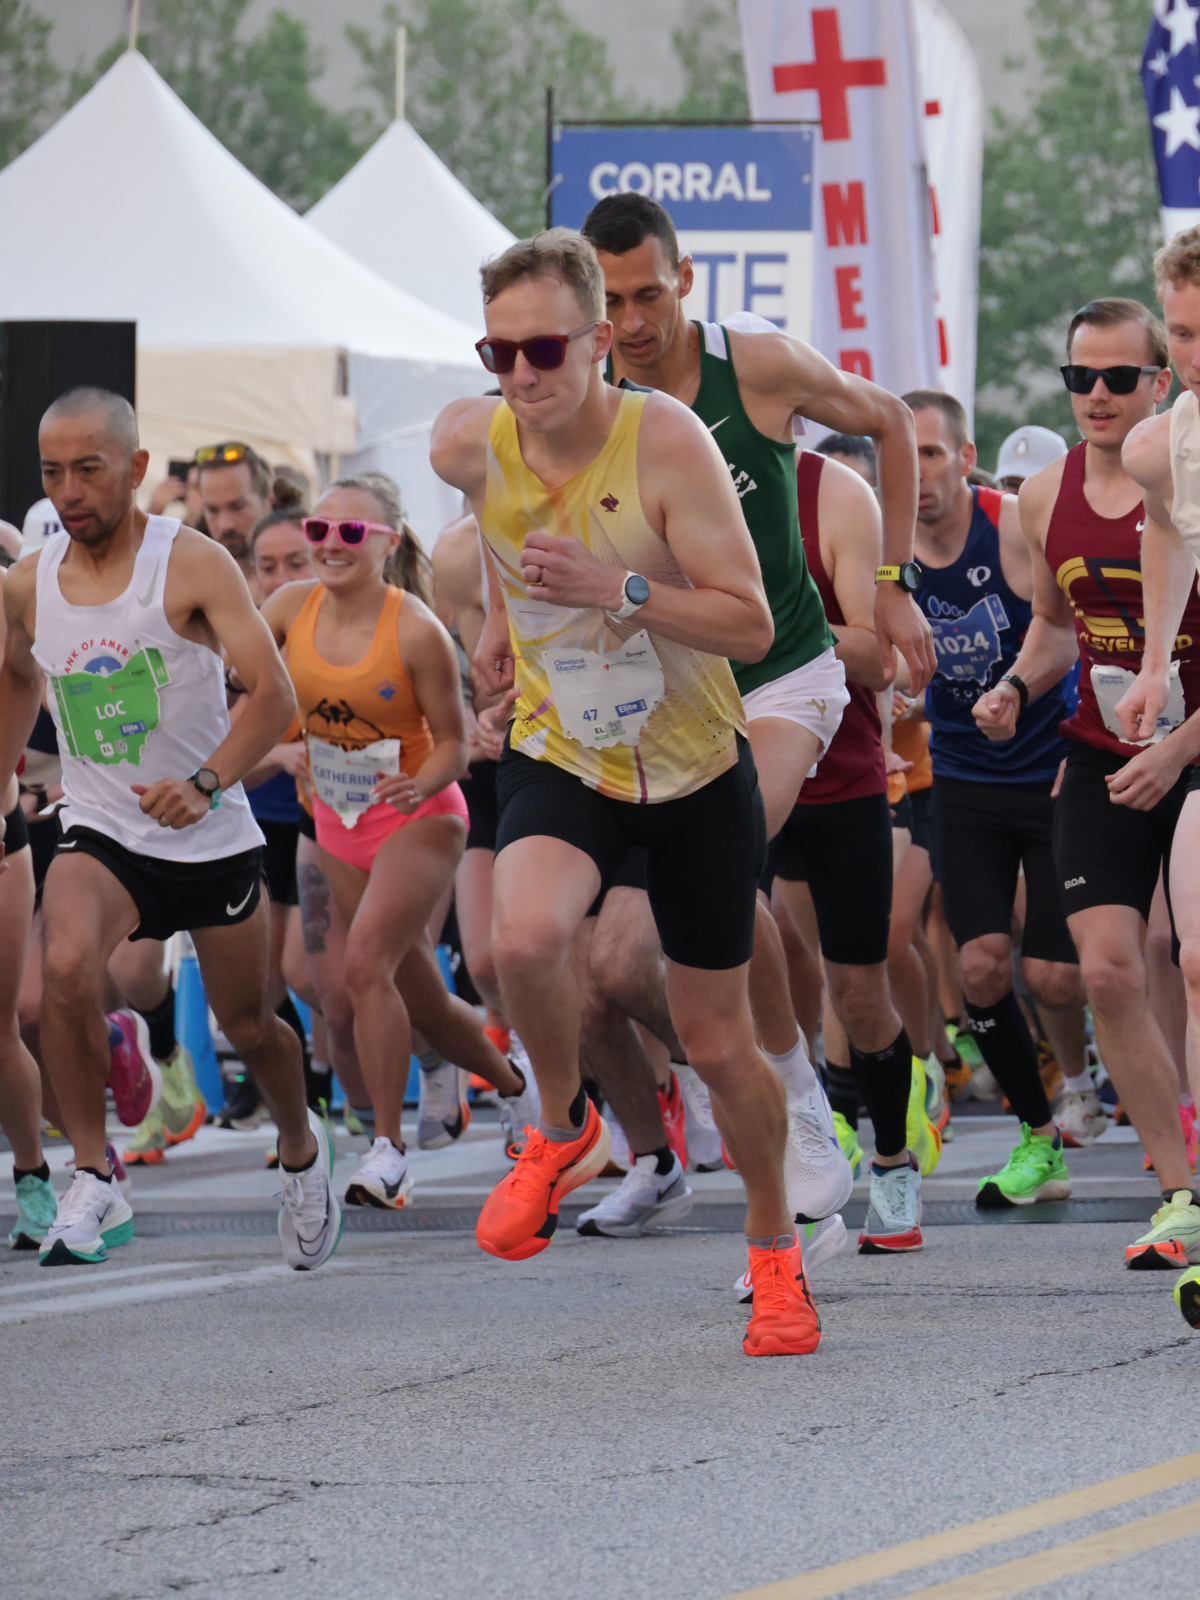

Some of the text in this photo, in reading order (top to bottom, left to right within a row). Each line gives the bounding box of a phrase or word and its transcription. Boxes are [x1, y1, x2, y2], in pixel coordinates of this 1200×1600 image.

[589, 161, 772, 201] CORRAL
[933, 631, 990, 655] 1024
[1079, 631, 1193, 653] CLEVELD
[64, 638, 133, 674] ANK OF AMER
[95, 700, 127, 720] LOC
[583, 709, 598, 721] 47
[618, 703, 638, 713] Elite
[94, 729, 104, 741] 8
[122, 724, 139, 734] Elite
[594, 726, 605, 734] EL
